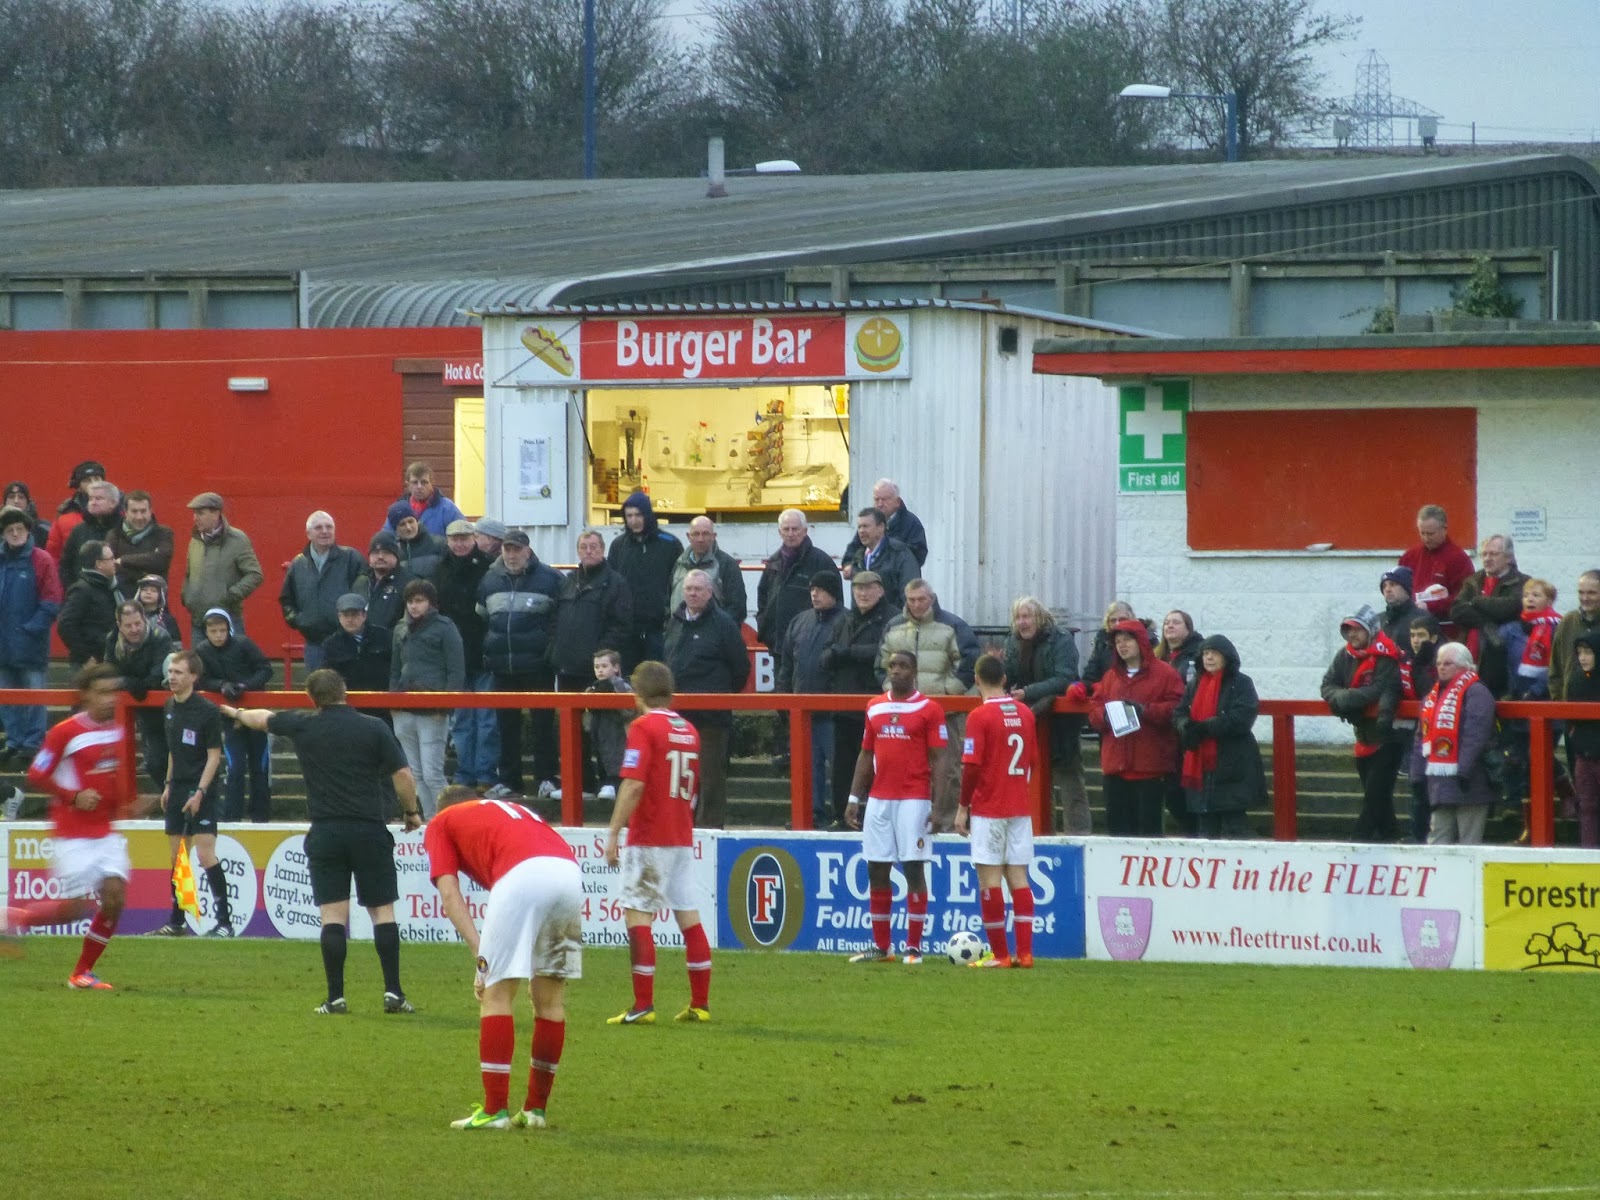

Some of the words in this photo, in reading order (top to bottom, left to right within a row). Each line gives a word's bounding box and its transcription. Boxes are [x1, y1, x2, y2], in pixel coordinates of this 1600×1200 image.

[616, 320, 743, 379] Burger
[751, 317, 812, 365] Bar
[444, 362, 463, 380] Hot
[464, 365, 472, 380] &
[472, 362, 485, 380] Co
[1127, 471, 1157, 487] First
[1160, 471, 1180, 486] aid
[1007, 733, 1026, 776] 2
[665, 750, 699, 800] 15
[1120, 855, 1226, 889] TRUST
[1232, 859, 1260, 891] in
[1268, 861, 1313, 893] the
[1323, 862, 1437, 898] FLEET
[752, 875, 781, 925] F
[275, 904, 285, 919] &
[287, 910, 322, 928] grass
[942, 908, 983, 932] the
[817, 938, 834, 951] All
[1171, 926, 1383, 954] www.fleettrust.co.uk
